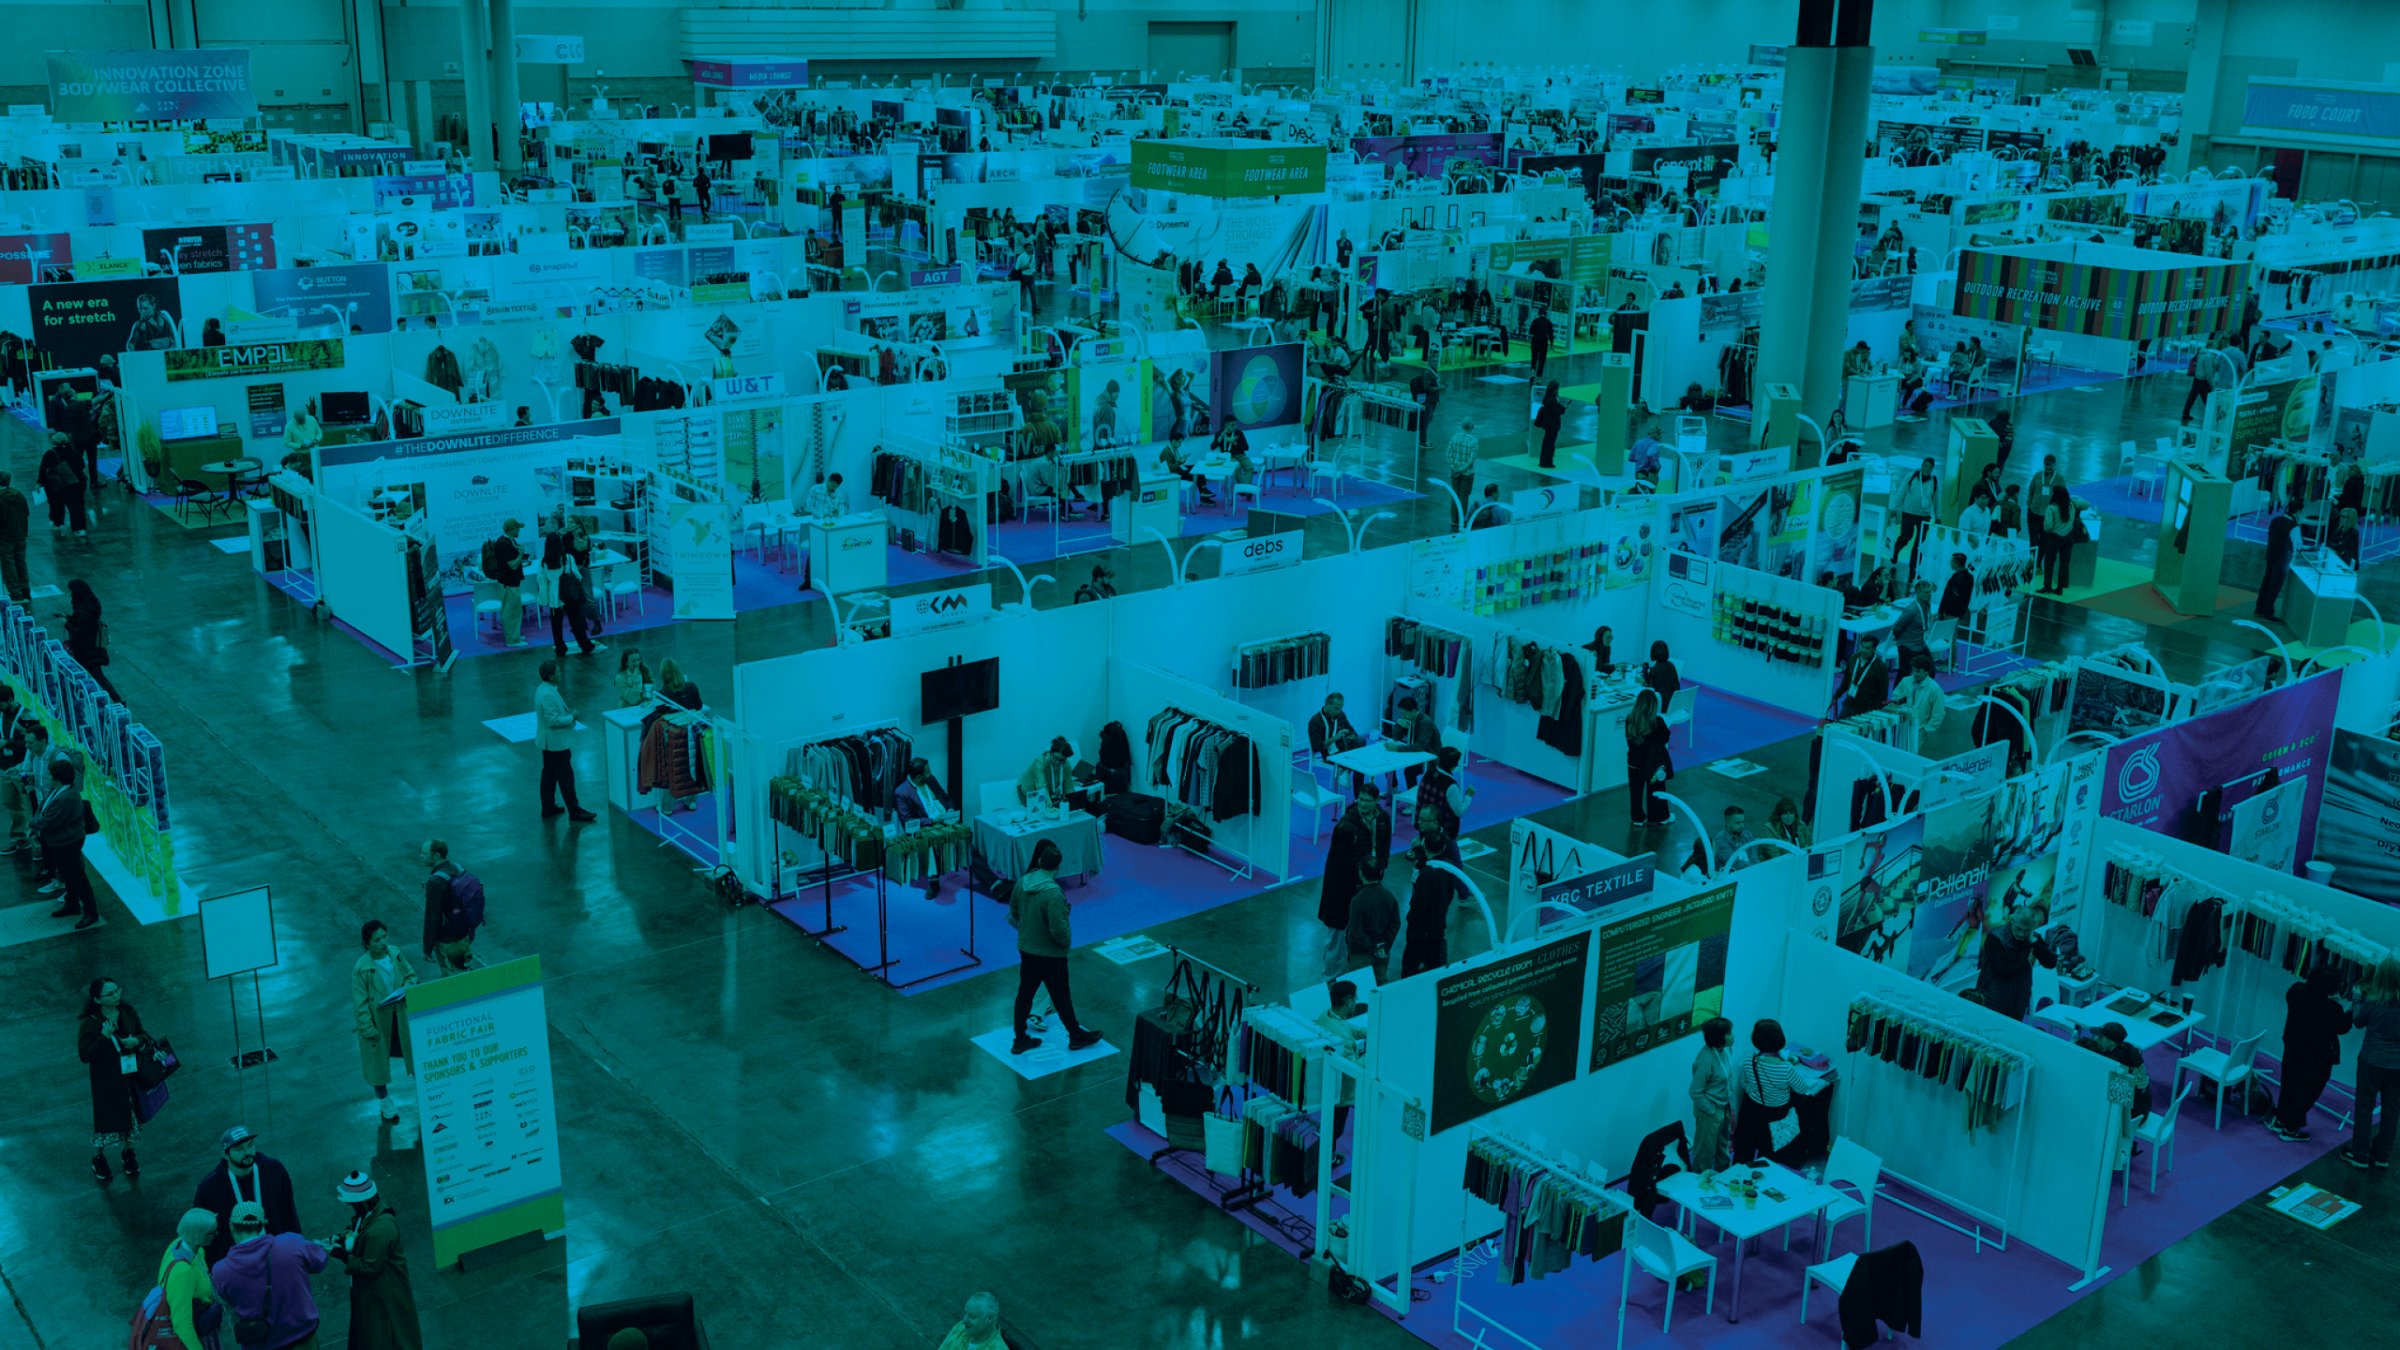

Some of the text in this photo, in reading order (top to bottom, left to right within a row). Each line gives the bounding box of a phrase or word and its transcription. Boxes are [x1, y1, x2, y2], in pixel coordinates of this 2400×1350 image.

[94, 64, 245, 81] INNOVATION ZONE
[769, 71, 792, 80] LOUNGE
[59, 78, 247, 96] BODYWEAR COLLECTIVE
[2288, 104, 2363, 123] FOOD COURT
[343, 152, 407, 161] INNOVATION
[175, 159, 218, 175] TECH
[1148, 162, 1208, 181] FOOTWEAR AREA
[1244, 166, 1309, 182] FOOTWEAR AREA
[1156, 219, 1190, 231] Dyneema
[1225, 217, 1243, 227] THE
[1225, 227, 1277, 241] STRONGEST
[190, 248, 223, 259] stretch
[193, 259, 223, 270] fabrics
[317, 275, 347, 284] BUTTON
[923, 271, 949, 283] AGT
[43, 298, 109, 312] A new era
[1963, 281, 2102, 312] OUTDOOR RECREATION ARCHIVE
[2138, 295, 2230, 315] OUTDOOR RECREATION ARCHIVE
[44, 311, 117, 327] for stretch
[725, 375, 774, 396] W&T
[430, 404, 498, 421] DOWNLITE
[450, 416, 482, 425] OUTDOOR
[395, 427, 560, 456] #THEDOWNLITEDIFFERENCE
[482, 454, 511, 464] QUALITY
[453, 484, 509, 500] DOWNLITE
[1244, 538, 1284, 557] debs
[2262, 745, 2289, 763] GREEN
[2299, 735, 2315, 749] ECO
[1586, 868, 1644, 898] TEXTILE
[1929, 860, 1990, 902] Pettenati
[1602, 916, 1651, 940] COMPUTERIZED
[1651, 905, 1682, 923] ENGINEER
[1440, 940, 1581, 998] CHEMICAL RECYCLE FROM CLOTHES
[426, 1012, 495, 1035] FUNCTIONAL
[427, 1028, 468, 1048] FABRIC
[470, 1022, 495, 1036] FAIR
[422, 1042, 500, 1071] THANK YOU TO OUR
[423, 1046, 529, 1084] SPONSORS & SUPPORTERS
